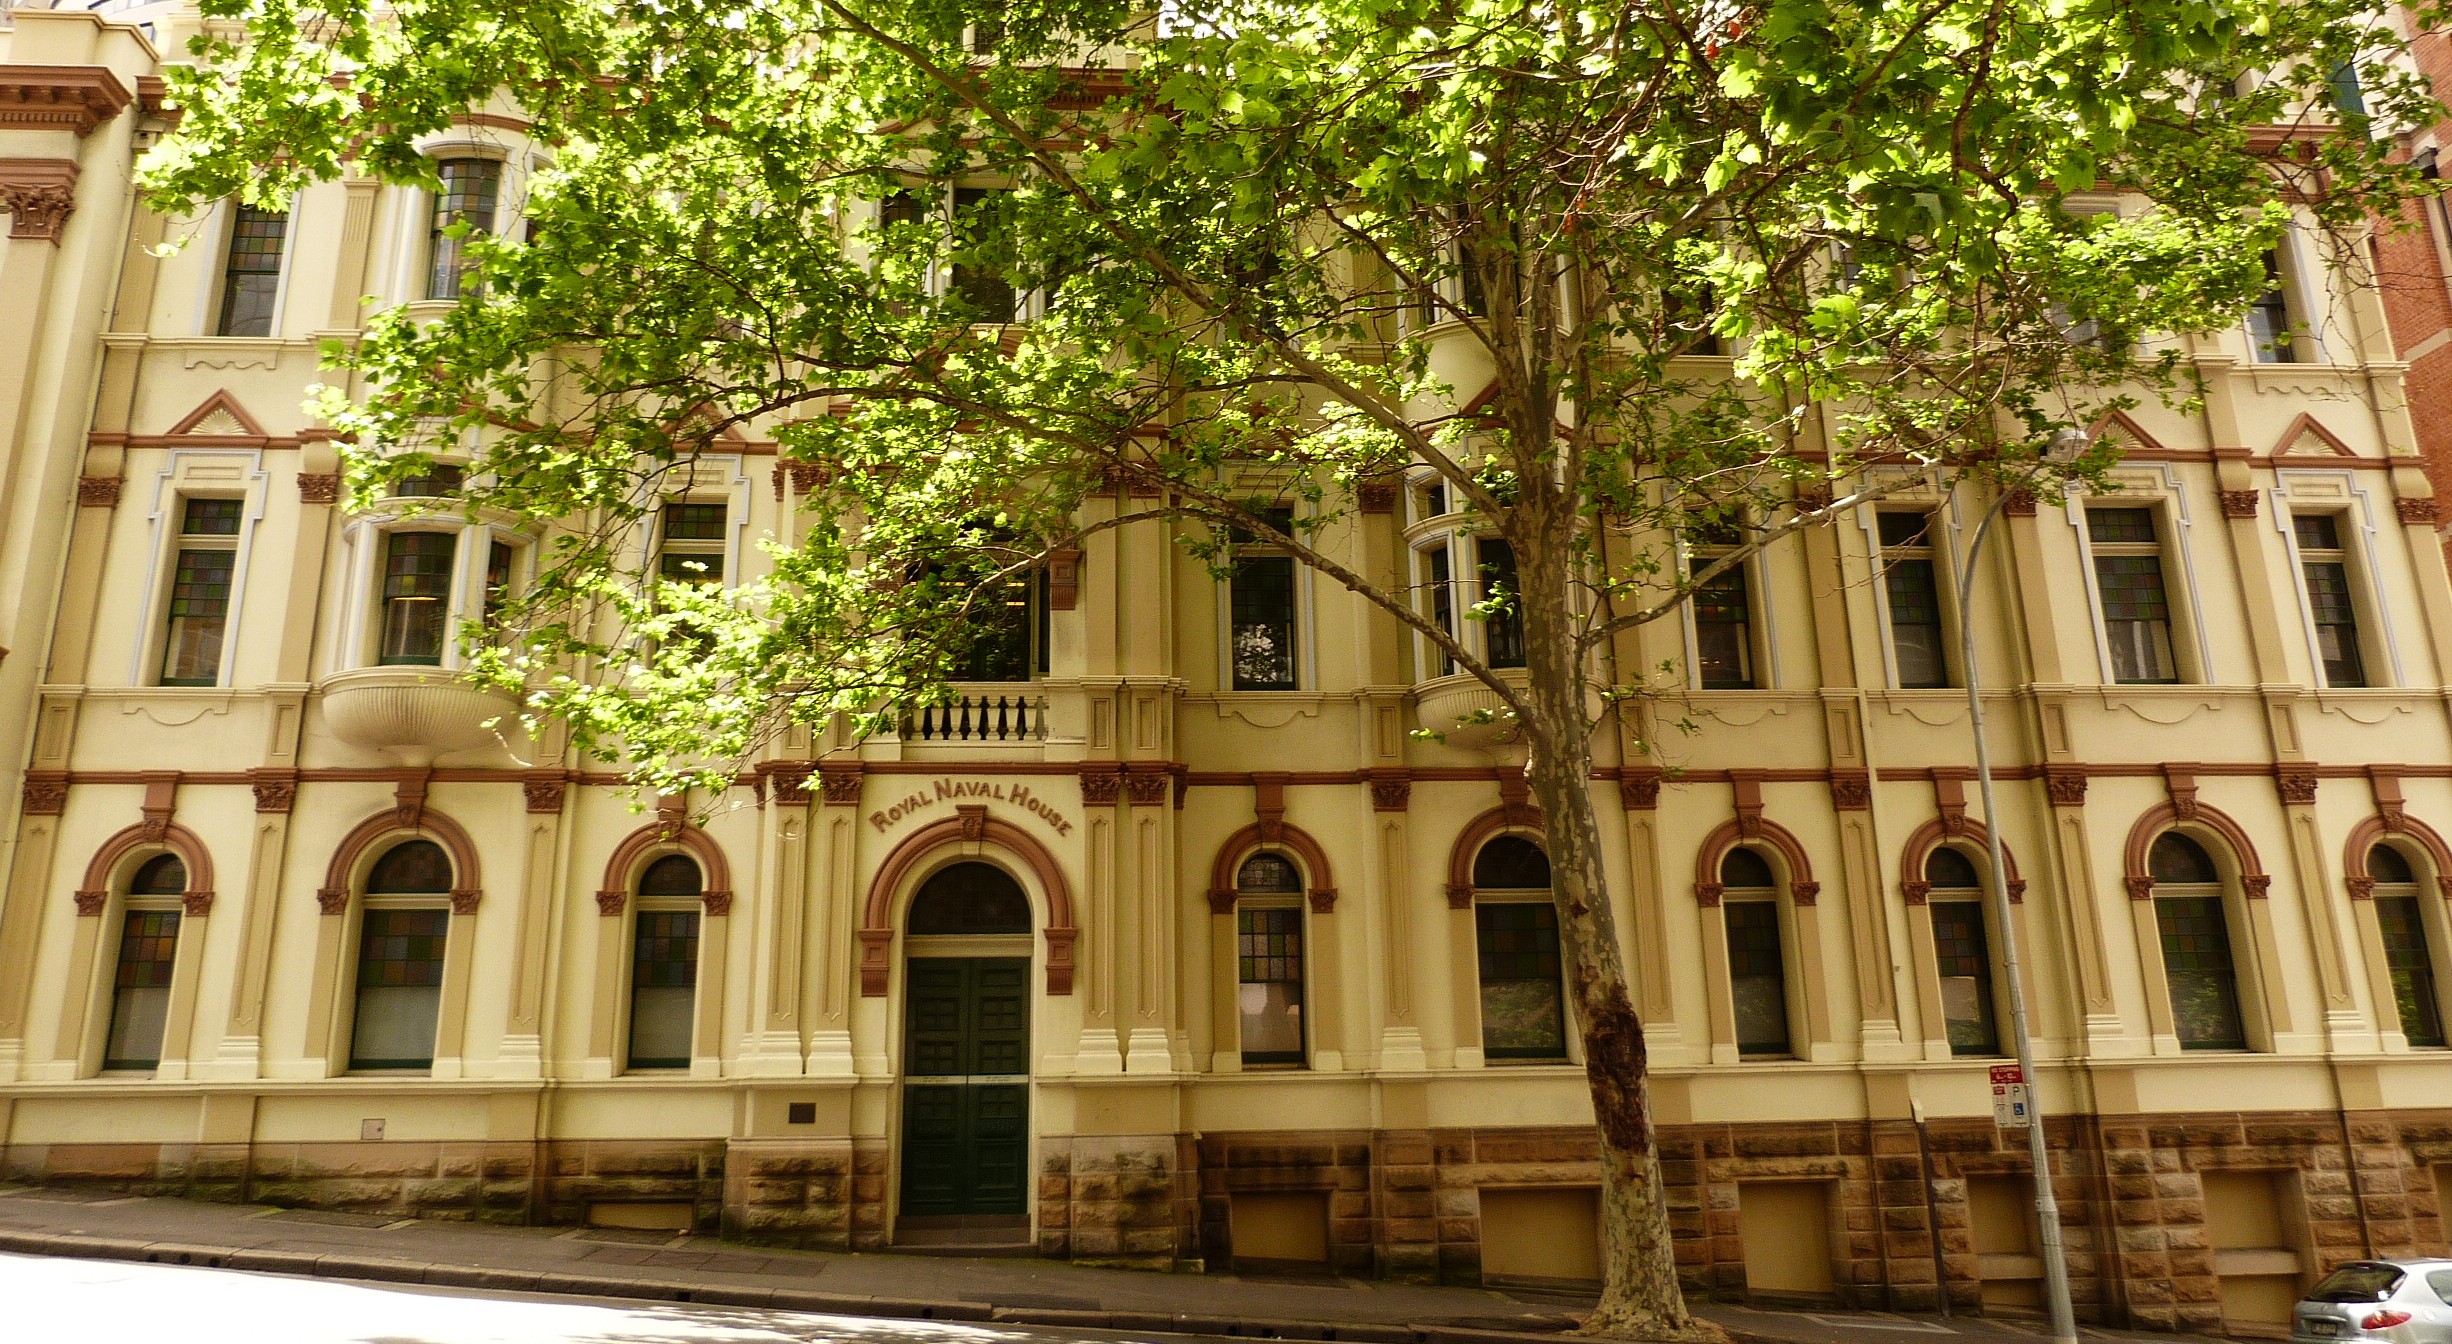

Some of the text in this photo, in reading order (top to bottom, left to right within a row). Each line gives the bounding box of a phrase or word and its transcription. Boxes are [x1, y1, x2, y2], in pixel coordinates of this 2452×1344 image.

[869, 778, 1073, 837] ROYAL NAVAL HOUSE
